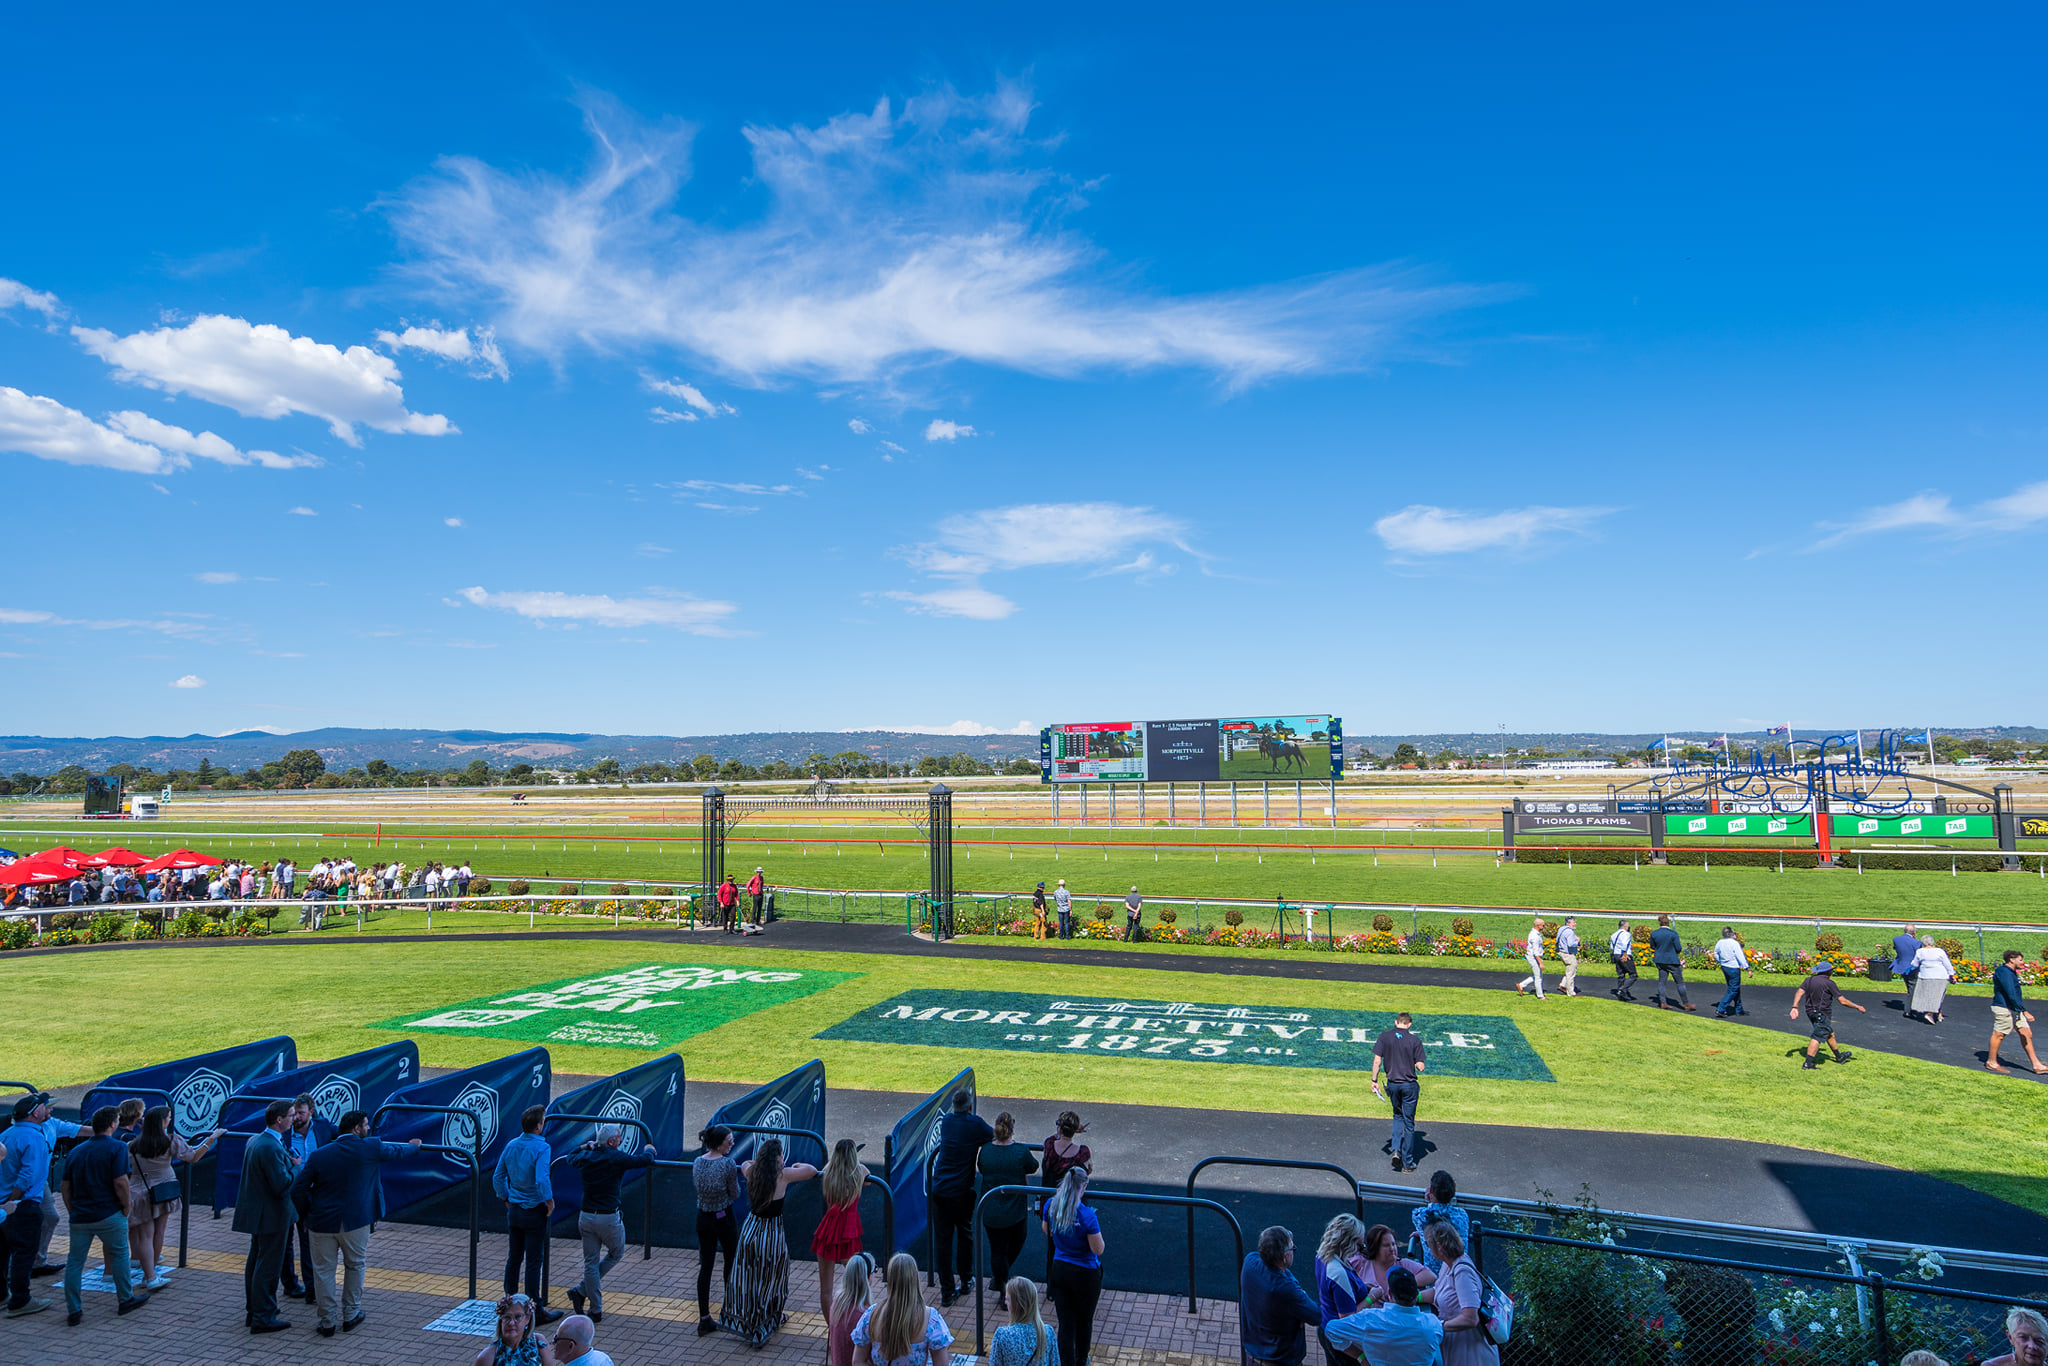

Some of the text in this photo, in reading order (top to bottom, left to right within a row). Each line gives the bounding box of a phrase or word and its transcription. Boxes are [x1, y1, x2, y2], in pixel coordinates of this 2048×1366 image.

[163, 791, 170, 799] 2
[1534, 817, 1631, 825] THOMAS FARMS.
[624, 966, 804, 983] LONG
[488, 992, 685, 1013] PLAY
[1005, 1033, 1053, 1041] EST
[1244, 1046, 1299, 1056] ADL
[276, 1052, 285, 1074] 1
[397, 1056, 410, 1080] 2
[532, 1064, 544, 1088] 3
[667, 1072, 678, 1096] 4
[177, 1081, 222, 1107] FURPHY
[316, 1088, 350, 1107] URPHY
[813, 1078, 821, 1104] 5
